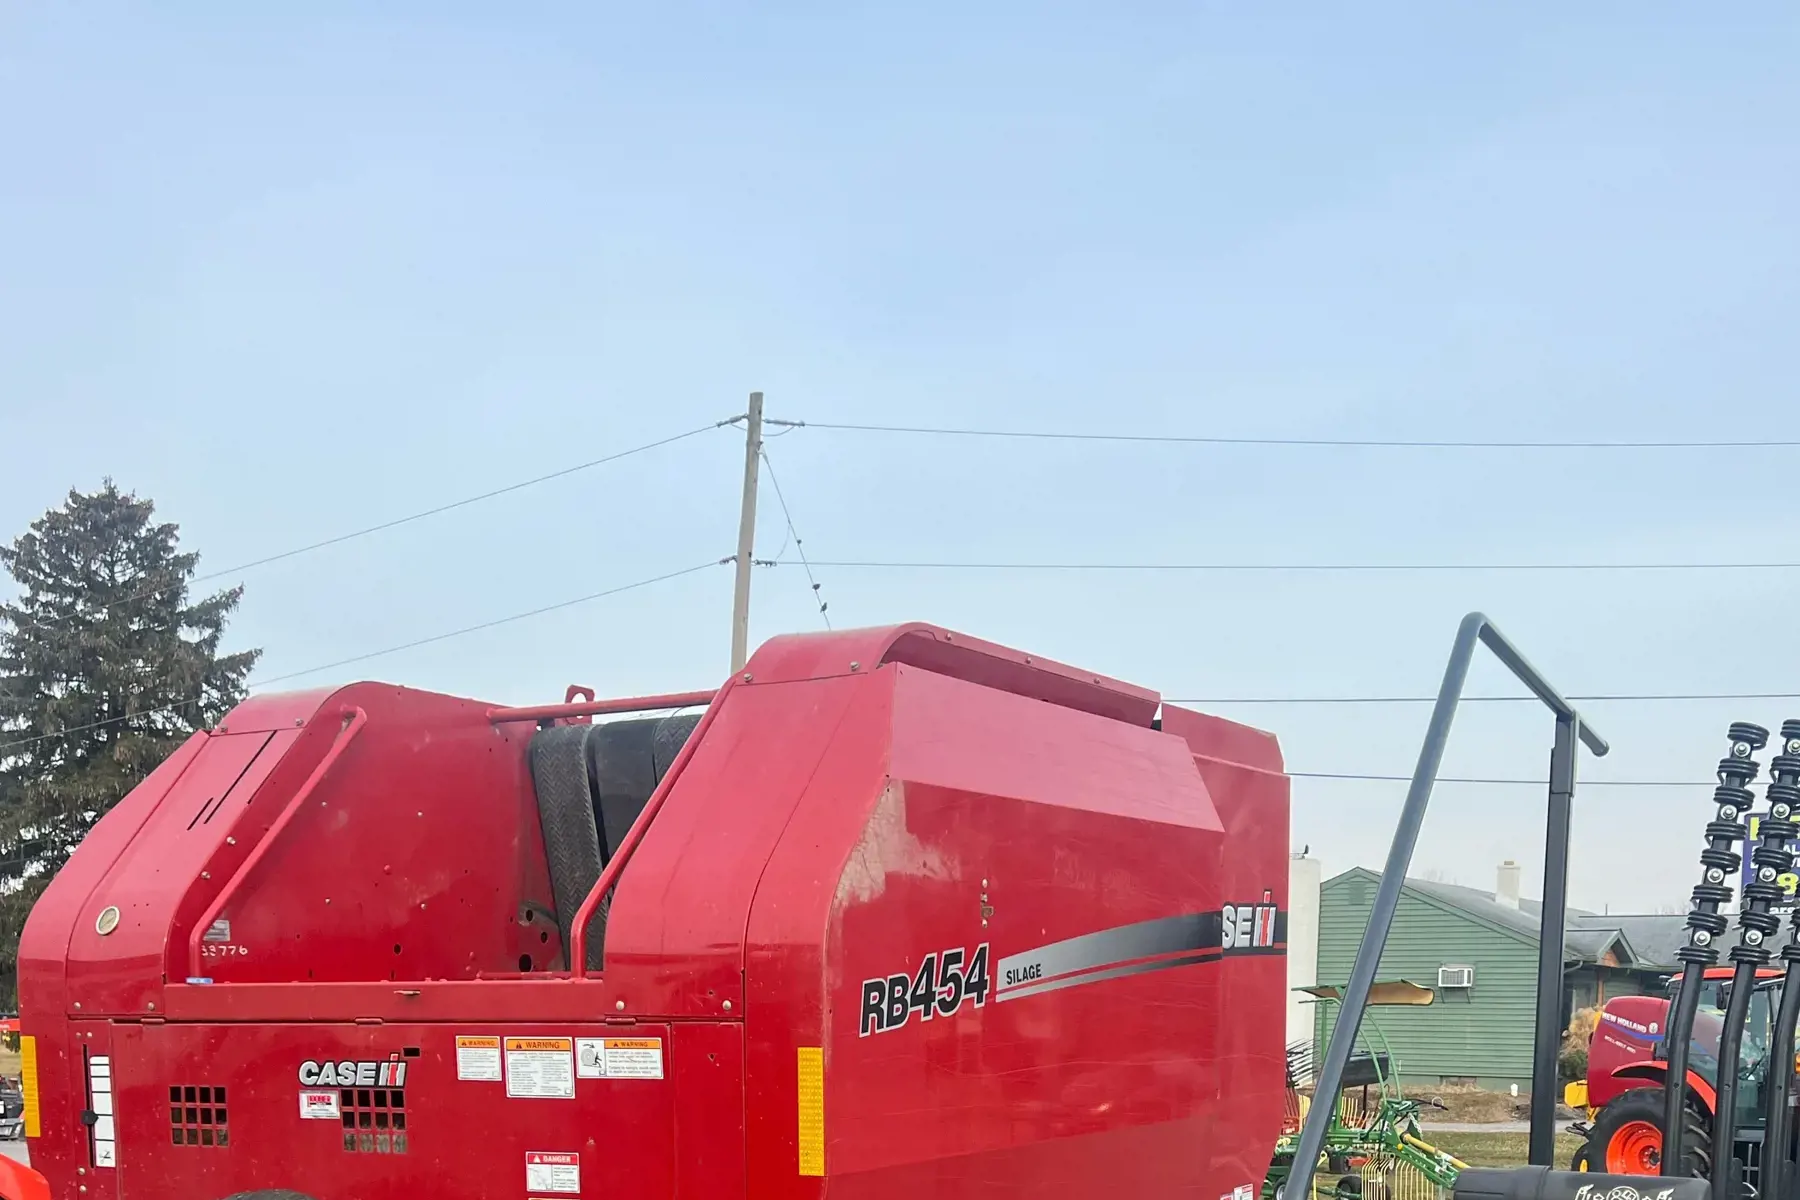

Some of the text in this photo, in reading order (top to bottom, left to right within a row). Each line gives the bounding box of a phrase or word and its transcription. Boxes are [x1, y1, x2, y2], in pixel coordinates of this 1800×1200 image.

[859, 942, 1042, 1038] RB454 SILAGE
[1602, 1012, 1647, 1033] NEW HOLLAND
[525, 1041, 561, 1049] WARNING
[543, 1155, 571, 1163] DANGER
